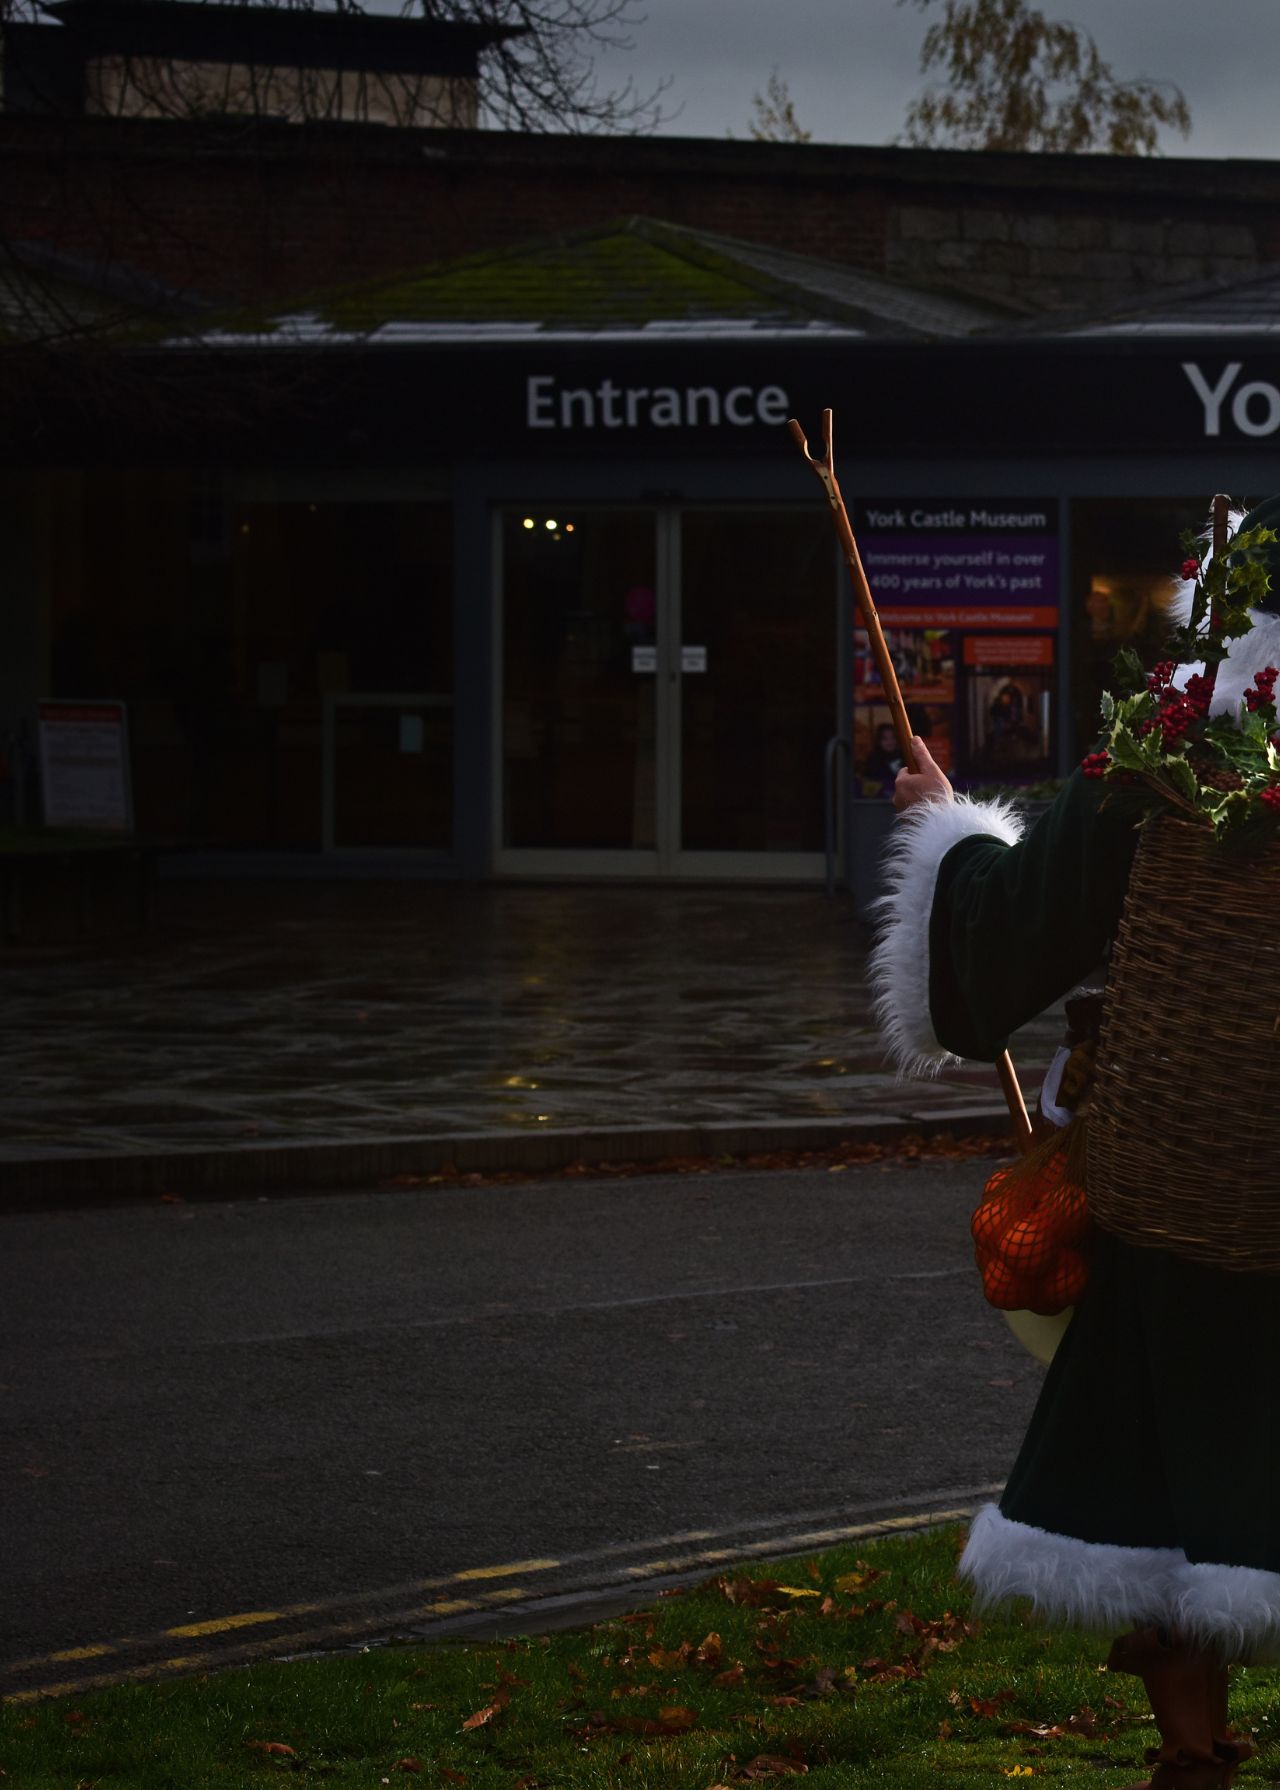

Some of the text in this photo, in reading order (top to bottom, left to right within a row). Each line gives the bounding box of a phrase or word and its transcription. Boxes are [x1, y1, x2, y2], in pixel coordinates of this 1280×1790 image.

[526, 375, 789, 428] Entrance
[866, 509, 1047, 528] York Castle Museum
[866, 551, 1046, 570] Immerse yourself in over
[872, 574, 1042, 593] 400 years of York's past
